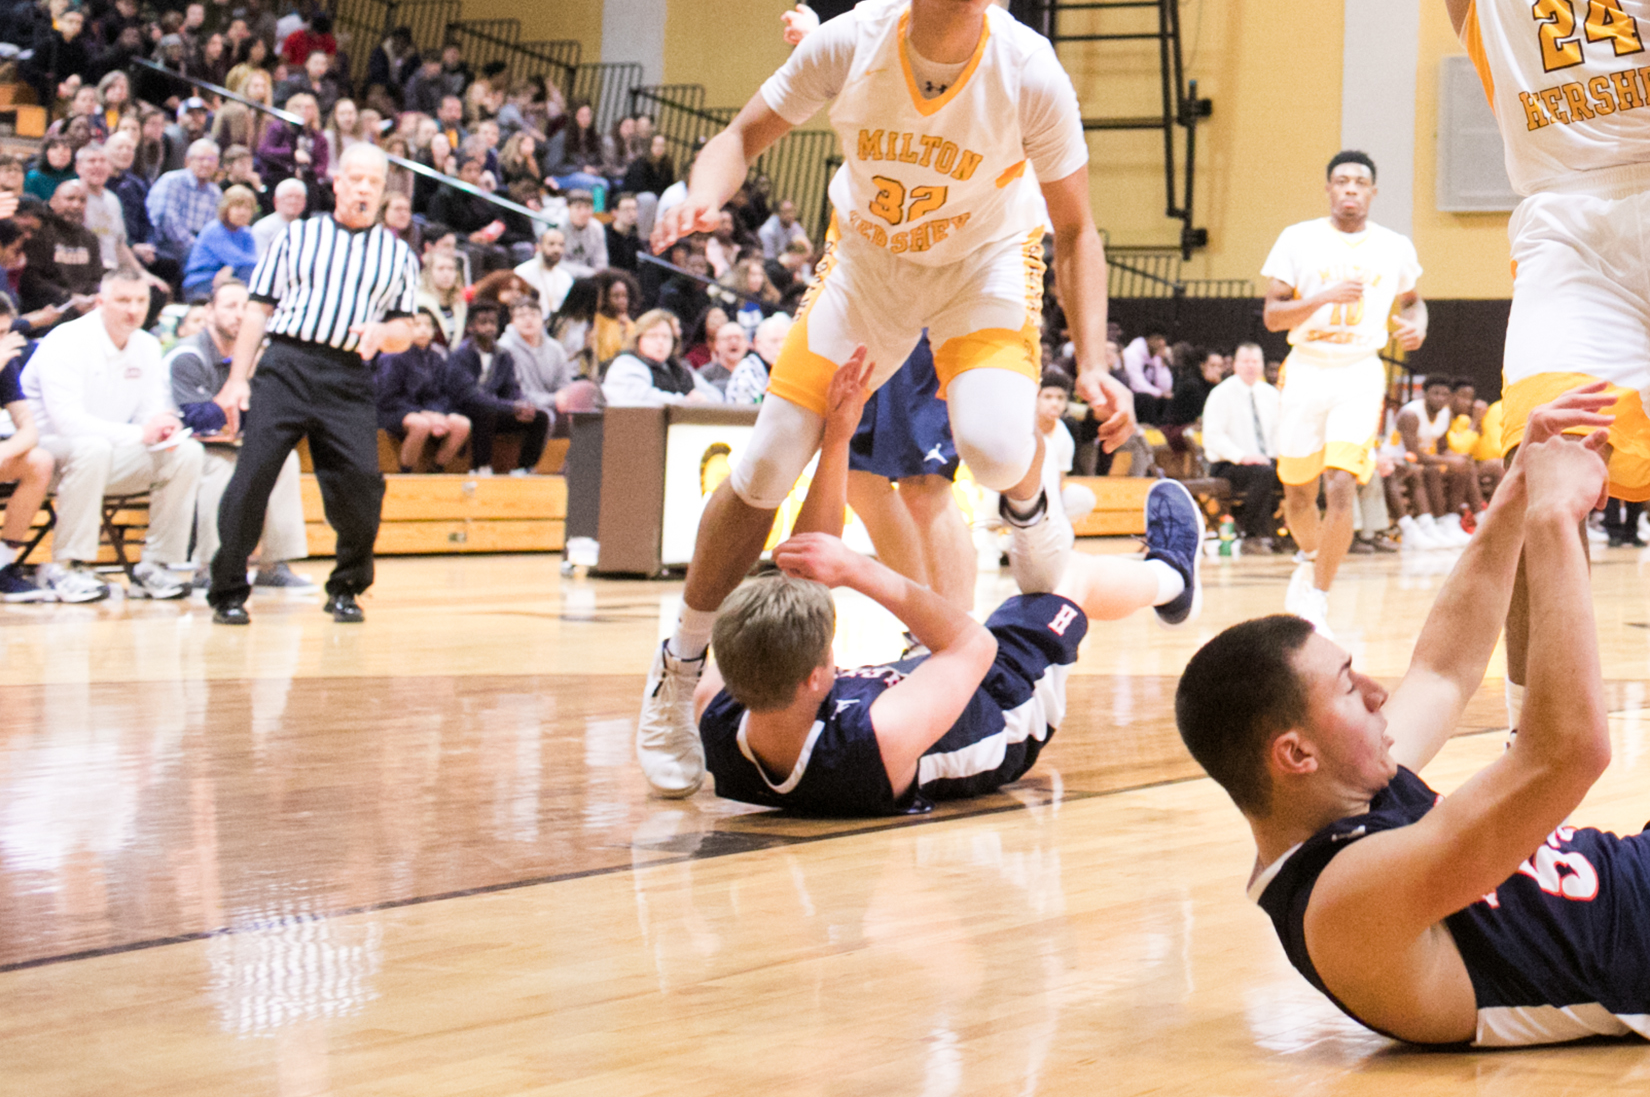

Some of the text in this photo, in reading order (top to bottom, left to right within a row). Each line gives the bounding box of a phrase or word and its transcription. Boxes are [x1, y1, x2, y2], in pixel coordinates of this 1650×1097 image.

[857, 128, 984, 181] MILTON
[869, 175, 948, 226] 32
[1048, 603, 1079, 636] H
